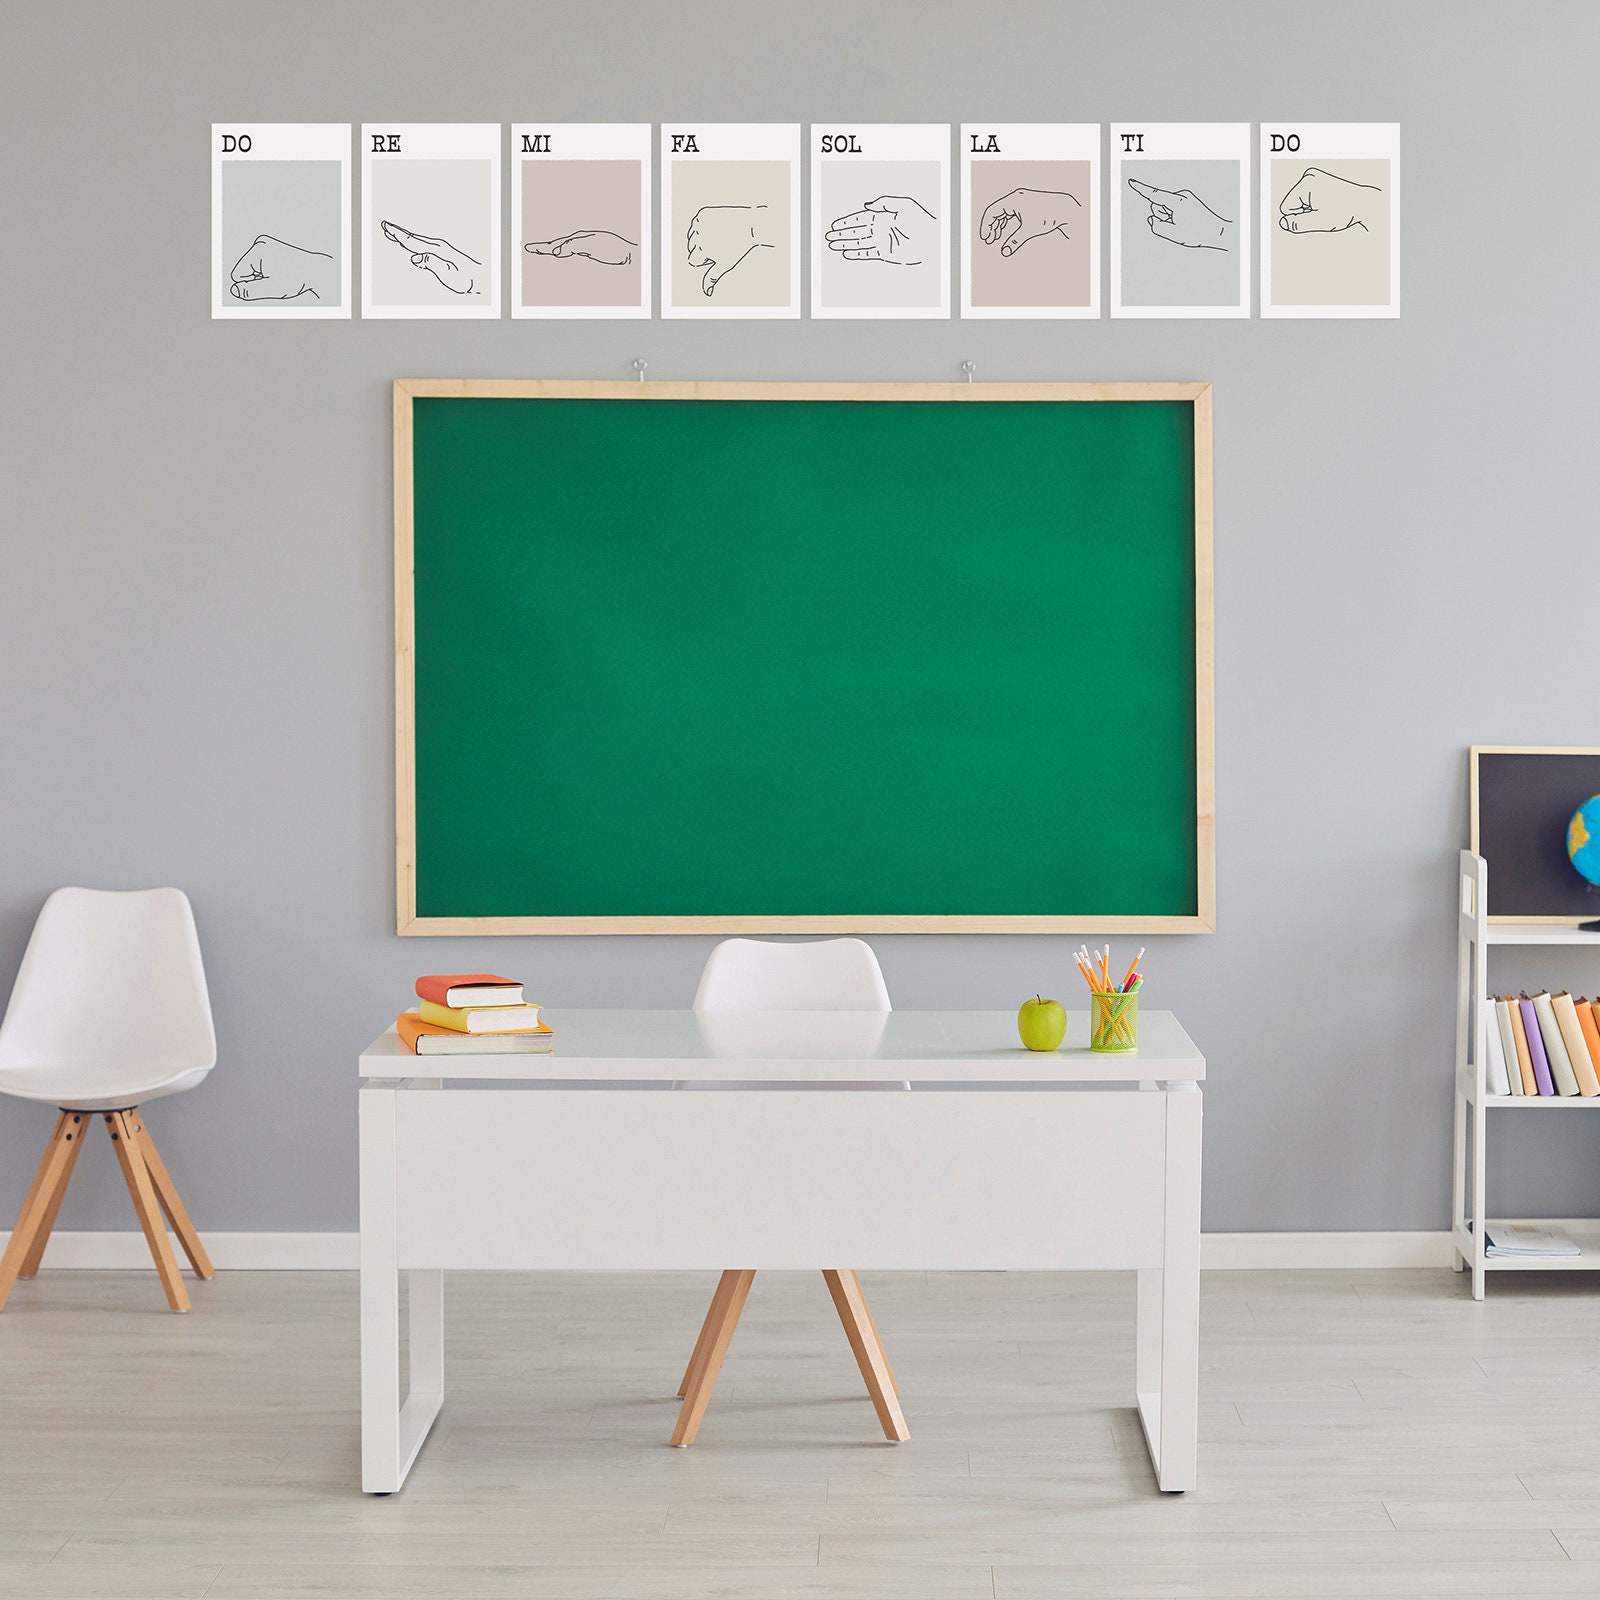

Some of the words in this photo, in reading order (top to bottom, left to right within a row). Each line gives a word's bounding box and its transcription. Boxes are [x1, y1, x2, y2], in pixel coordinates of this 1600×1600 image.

[222, 135, 252, 153] DO
[372, 135, 402, 153] RE
[522, 135, 551, 153] MI
[672, 135, 700, 153] FA
[821, 135, 862, 153] SOL
[971, 135, 1001, 153] LA
[1121, 134, 1145, 152] TI
[1271, 134, 1301, 153] DO
